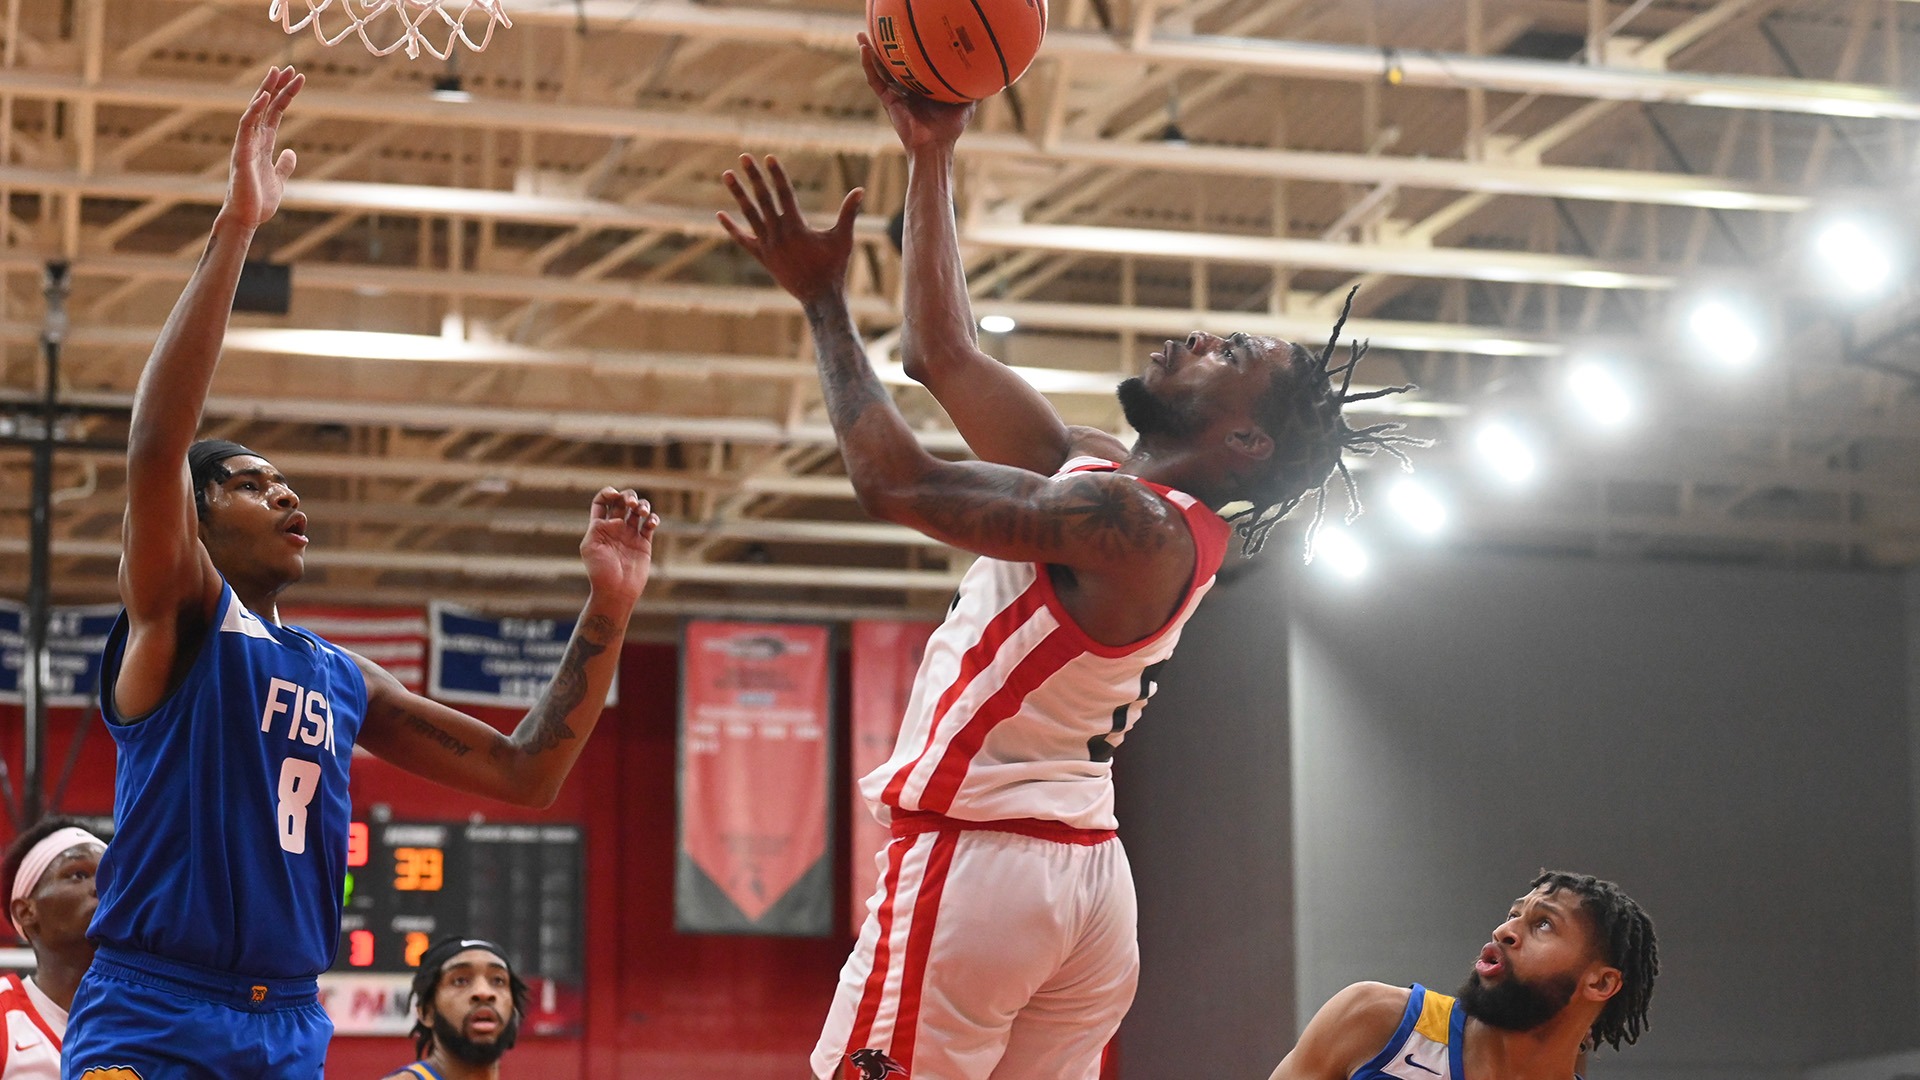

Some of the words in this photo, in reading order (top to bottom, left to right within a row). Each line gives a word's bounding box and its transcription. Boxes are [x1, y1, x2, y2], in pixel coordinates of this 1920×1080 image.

[877, 16, 934, 95] ELITE
[277, 756, 322, 855] 8
[394, 847, 444, 891] 39
